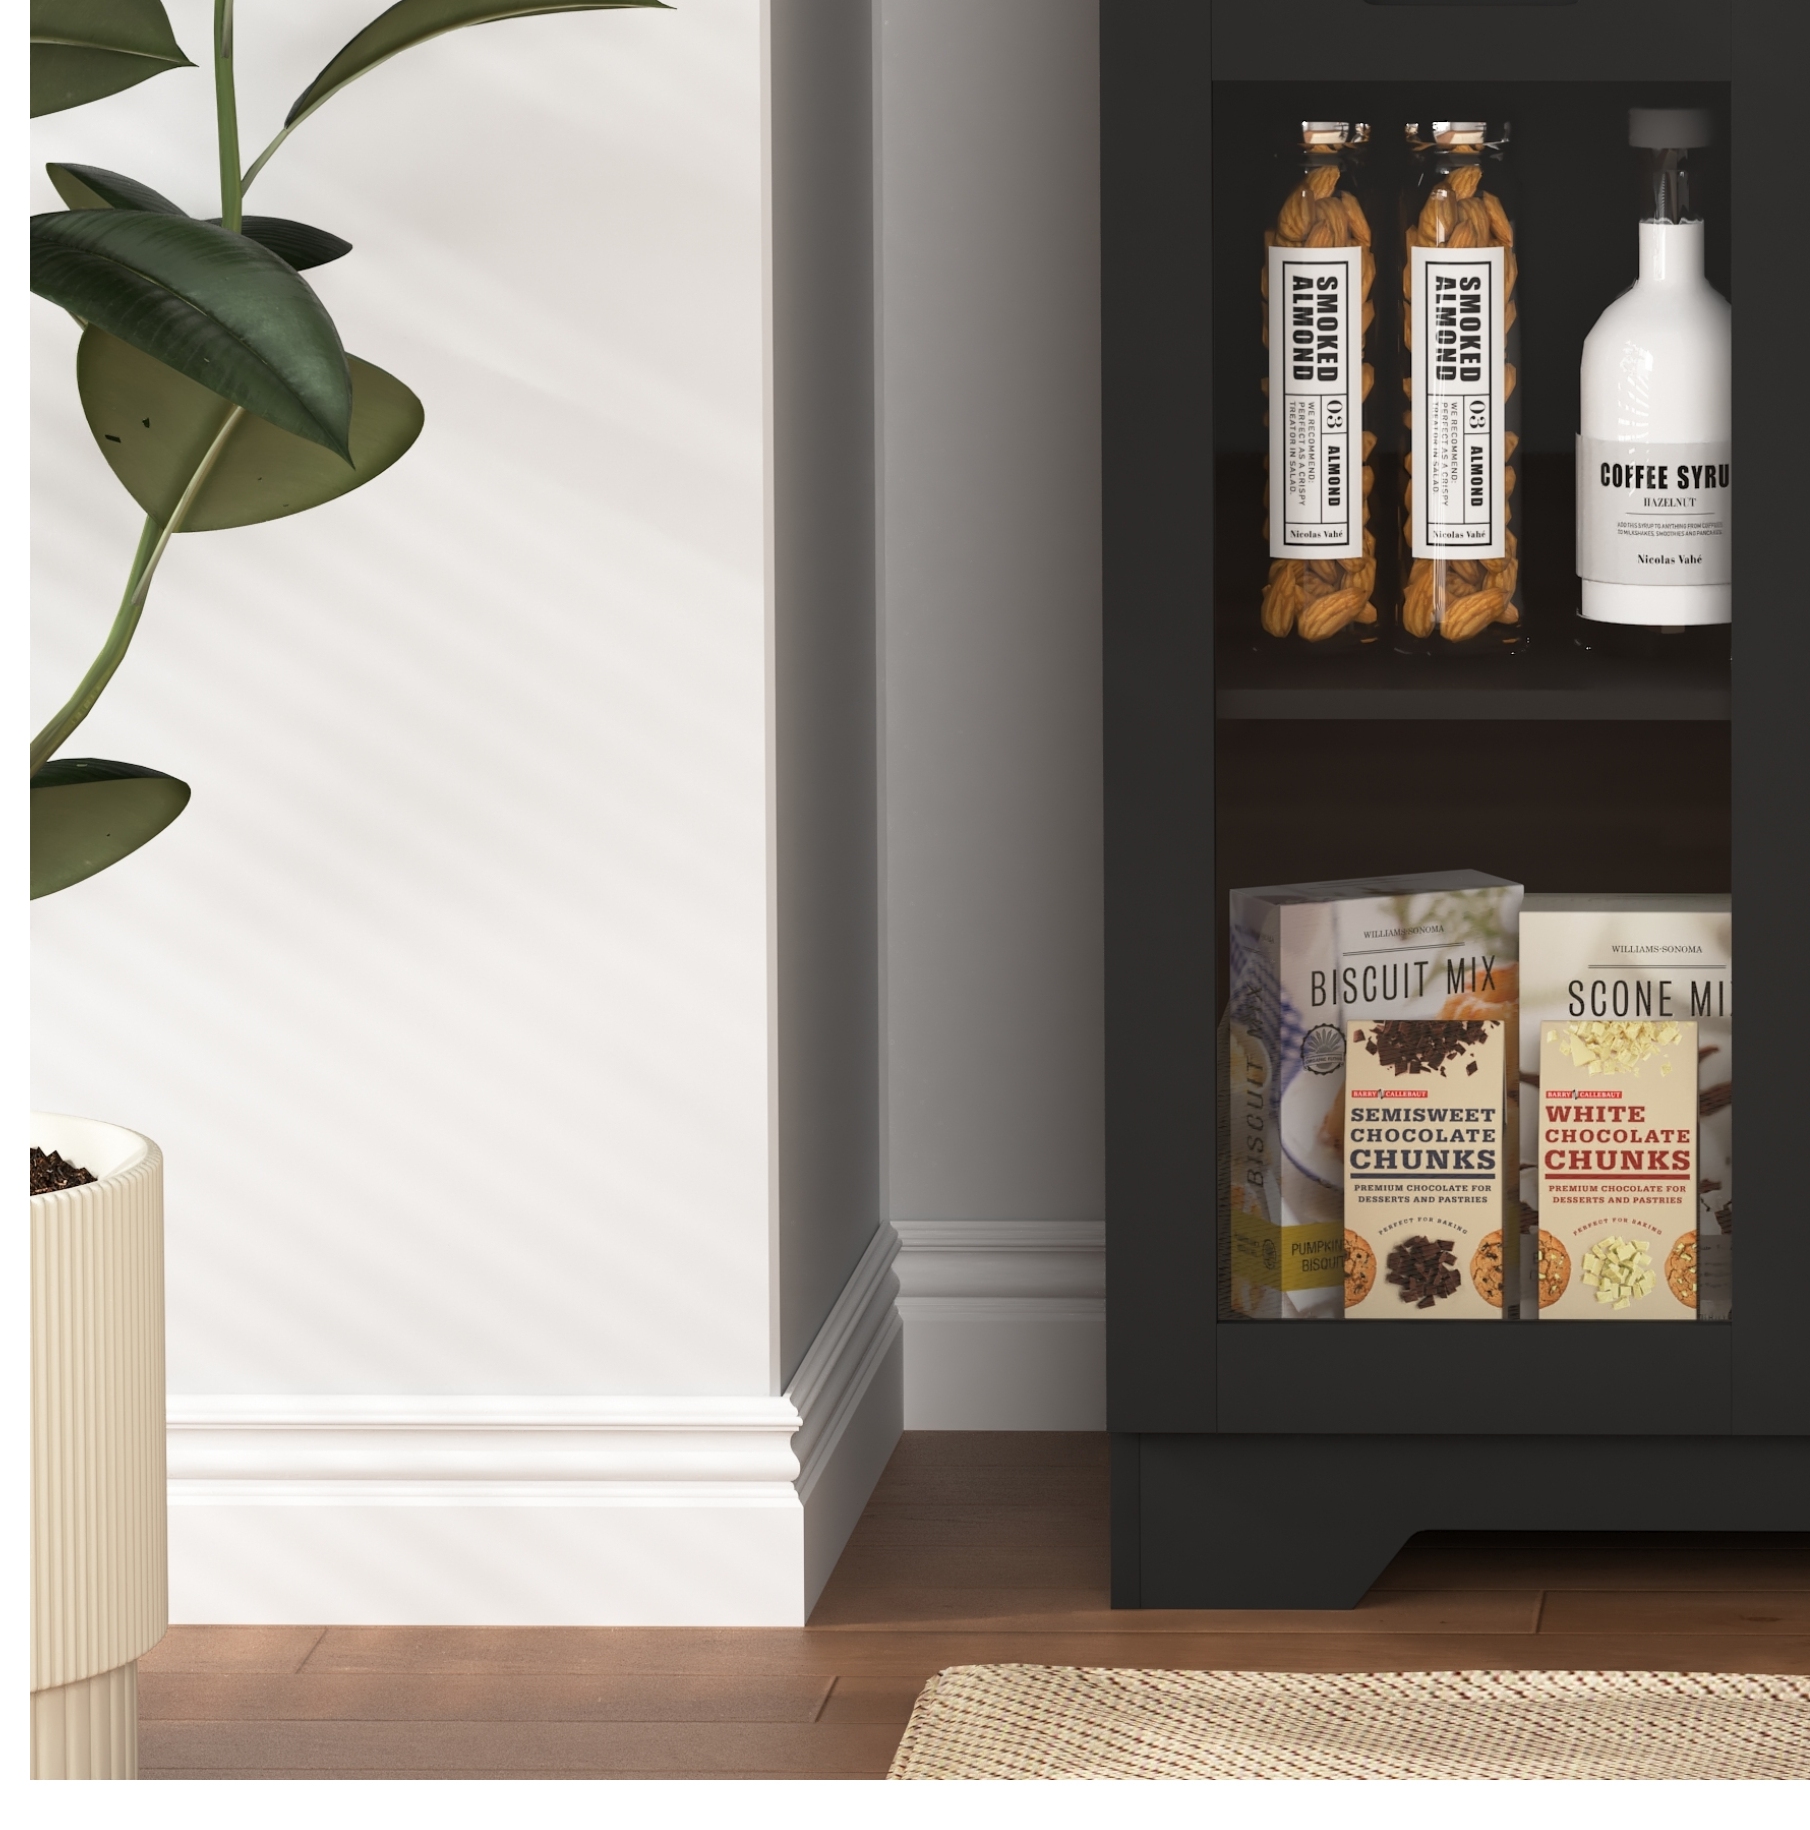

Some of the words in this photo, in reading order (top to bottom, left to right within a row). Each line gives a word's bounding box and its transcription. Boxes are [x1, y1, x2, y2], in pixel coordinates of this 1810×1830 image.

[1292, 275, 1314, 381] ALMOND
[1316, 276, 1338, 382] SMOKED
[1435, 275, 1457, 381] ALMOND
[1459, 276, 1481, 382] SMOKED
[1308, 401, 1316, 416] WE
[1326, 400, 1343, 428] 03
[1450, 402, 1458, 416] WE
[1469, 400, 1486, 429] 03
[1298, 401, 1306, 445] PERFECT
[1441, 402, 1449, 445] PERFECT
[1289, 447, 1297, 458] IN
[1298, 447, 1306, 460] AS
[1308, 419, 1316, 484] RECOMMEND:
[1441, 447, 1449, 460] AS
[1450, 419, 1458, 484] RECOMMEND:
[1289, 460, 1297, 495] SALAD.
[1328, 445, 1341, 506] ALMOND
[1470, 445, 1484, 507] ALMOND
[1600, 462, 1669, 489] COFFEE
[1677, 463, 1730, 489] SYRU
[1298, 471, 1306, 506] CRISPY
[1441, 472, 1449, 506] CRISPY
[1643, 497, 1697, 507] HAZELNUT
[1290, 529, 1321, 538] Nicolas
[1323, 529, 1343, 538] Vahé
[1433, 530, 1464, 539] Nicolas
[1466, 529, 1486, 539] Vahé
[1637, 554, 1676, 564] Nicolas
[1678, 554, 1703, 564] Vahé
[1611, 945, 1703, 953] WILLIAMS-SONOMA
[1311, 961, 1429, 1007] BISCUIT
[1447, 955, 1496, 995] MIX
[1568, 980, 1674, 1017] SCONE
[1690, 980, 1732, 1017] MI
[1246, 981, 1265, 1041] MIX
[1353, 1090, 1377, 1098] BARRY
[1385, 1090, 1427, 1098] CALLEBAUT
[1246, 1054, 1265, 1188] BISCUIT
[1350, 1107, 1496, 1122] SEMISWEET
[1545, 1106, 1645, 1123] WHITE
[1350, 1128, 1496, 1142] CHOCOLATE
[1545, 1129, 1690, 1143] CHOCOLATE
[1350, 1149, 1496, 1170] CHUNKS
[1545, 1149, 1690, 1171] CHUNKS
[1354, 1184, 1403, 1192] PREMIUM
[1406, 1184, 1468, 1192] CHOCOLATE
[1471, 1184, 1492, 1192] FOR
[1666, 1185, 1686, 1193] FOR
[1553, 1196, 1605, 1204] DESSERTS
[1608, 1196, 1630, 1204] AND
[1633, 1196, 1683, 1204] PASTRIES
[1378, 1217, 1414, 1235] PERFECT
[1436, 1218, 1468, 1235] BAKING
[1573, 1218, 1609, 1236] PERFECT
[1631, 1218, 1663, 1235] BAKING
[1291, 1238, 1343, 1256] PUMPKIN
